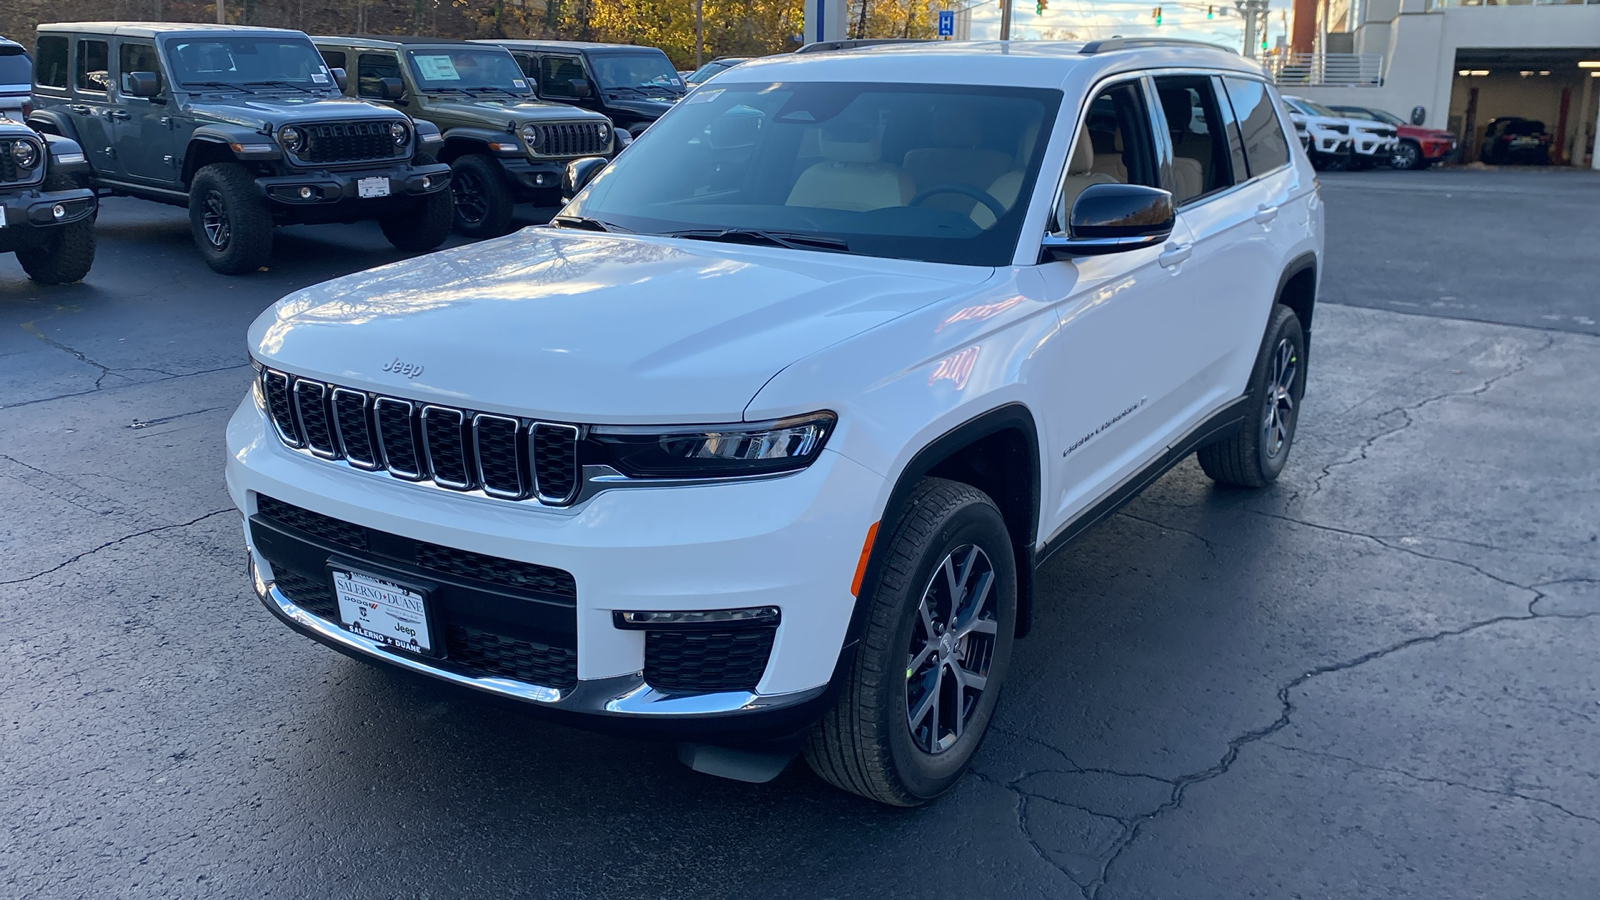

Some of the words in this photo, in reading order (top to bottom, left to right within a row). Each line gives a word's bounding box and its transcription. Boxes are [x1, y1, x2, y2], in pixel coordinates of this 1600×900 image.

[941, 16, 951, 29] H
[382, 357, 424, 379] Jeep
[337, 579, 382, 601] SALERNO
[387, 593, 423, 613] DUANE
[349, 626, 384, 642] SALERNO
[395, 640, 421, 653] DUANE
[394, 622, 416, 637] Jeep
